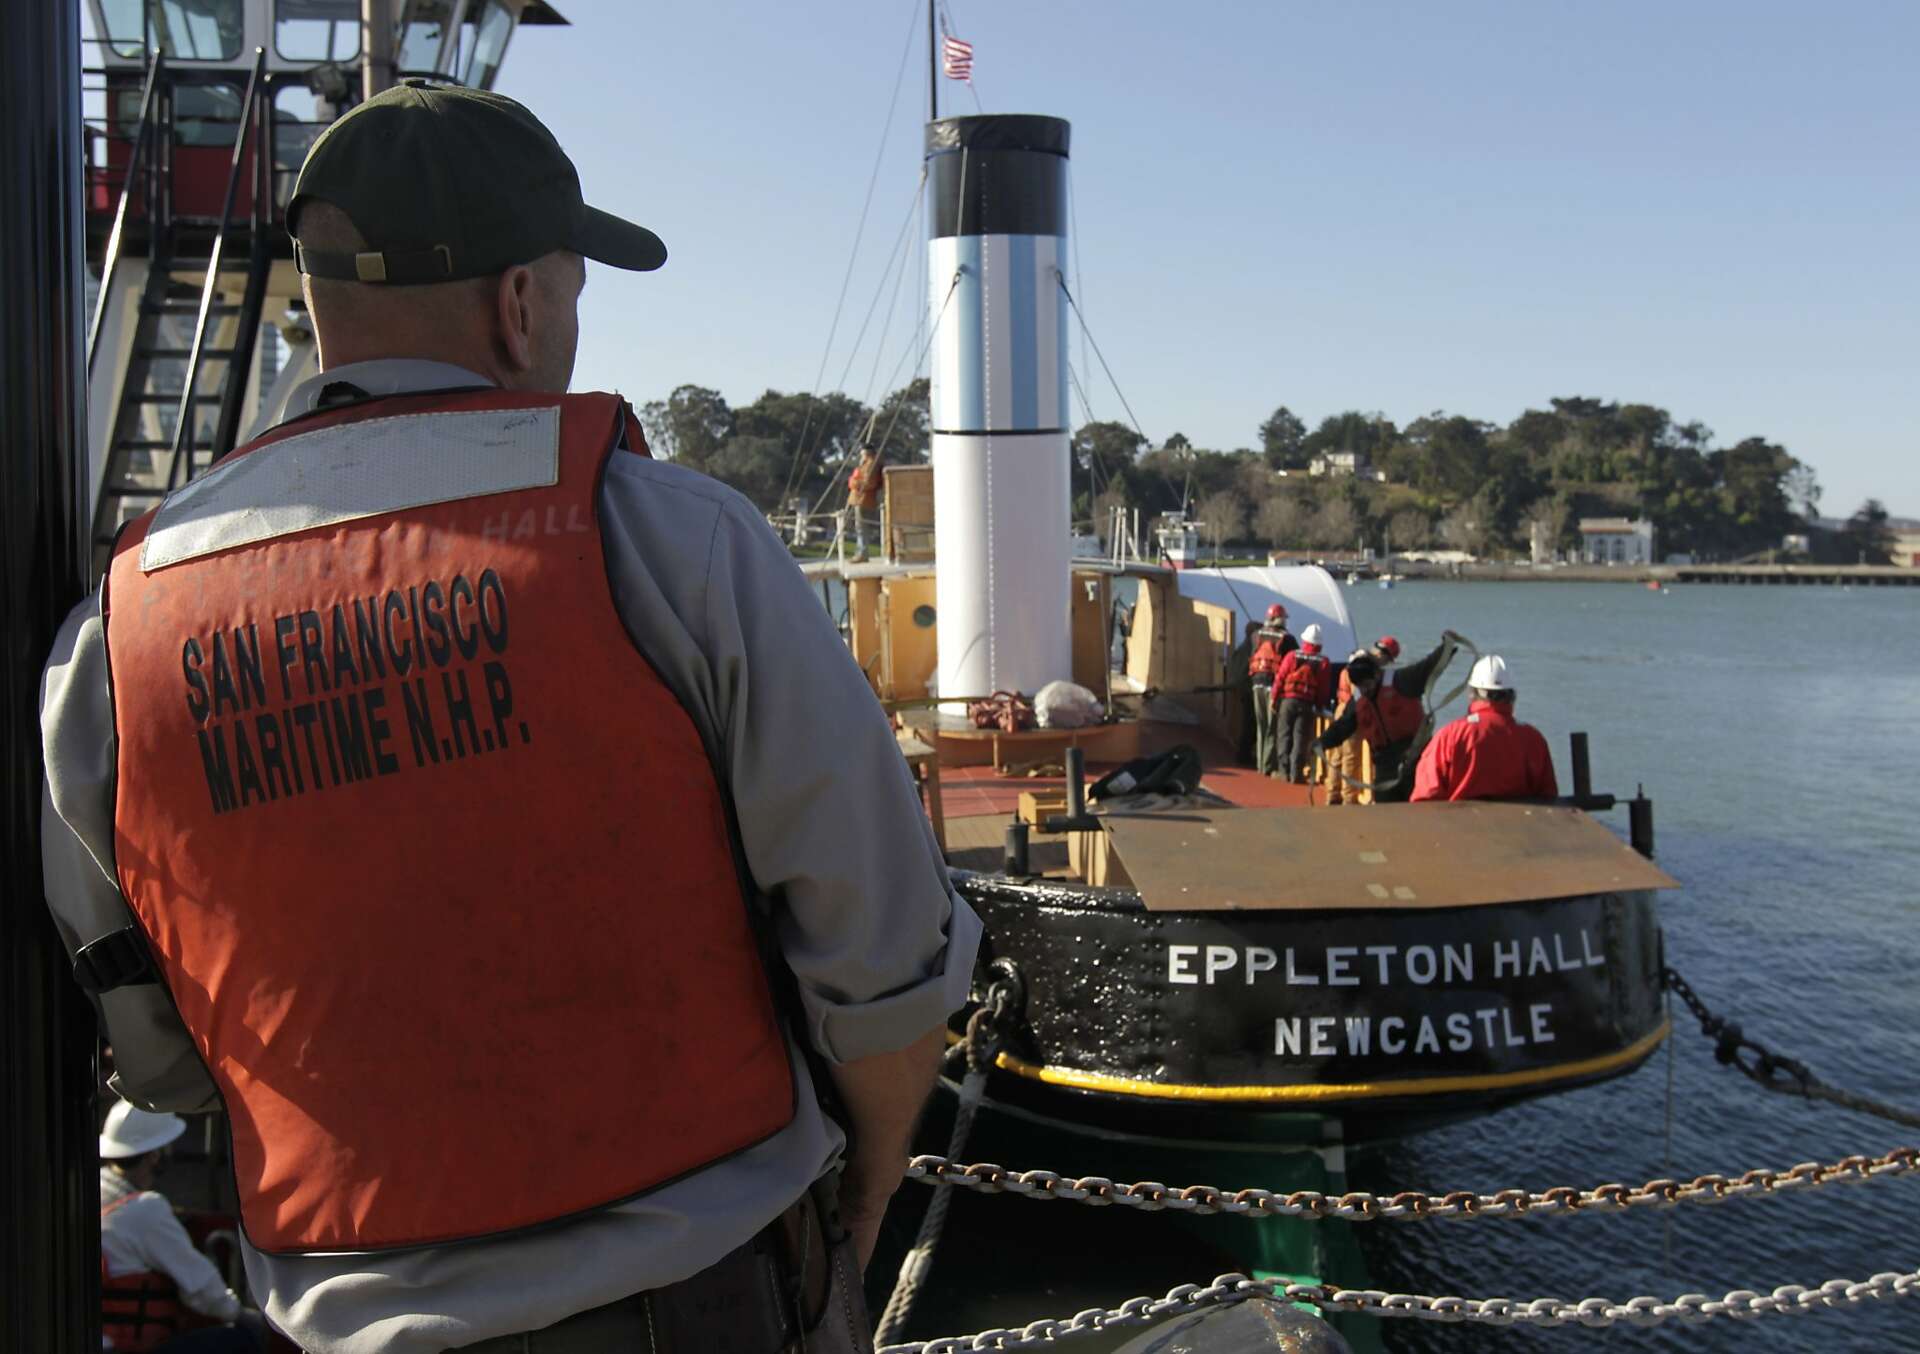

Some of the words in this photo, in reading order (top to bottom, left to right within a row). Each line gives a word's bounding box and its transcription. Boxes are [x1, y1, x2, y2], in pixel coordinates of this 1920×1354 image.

[480, 503, 590, 548] HALL
[182, 623, 266, 724] SAN
[275, 568, 509, 699] FRANCISCO
[198, 687, 400, 814] MARITIME
[404, 662, 531, 768] N.H.P.
[1168, 944, 1473, 986] EPPLETON
[1494, 930, 1606, 979] HALL
[1274, 1004, 1555, 1056] NEWCASTLE
